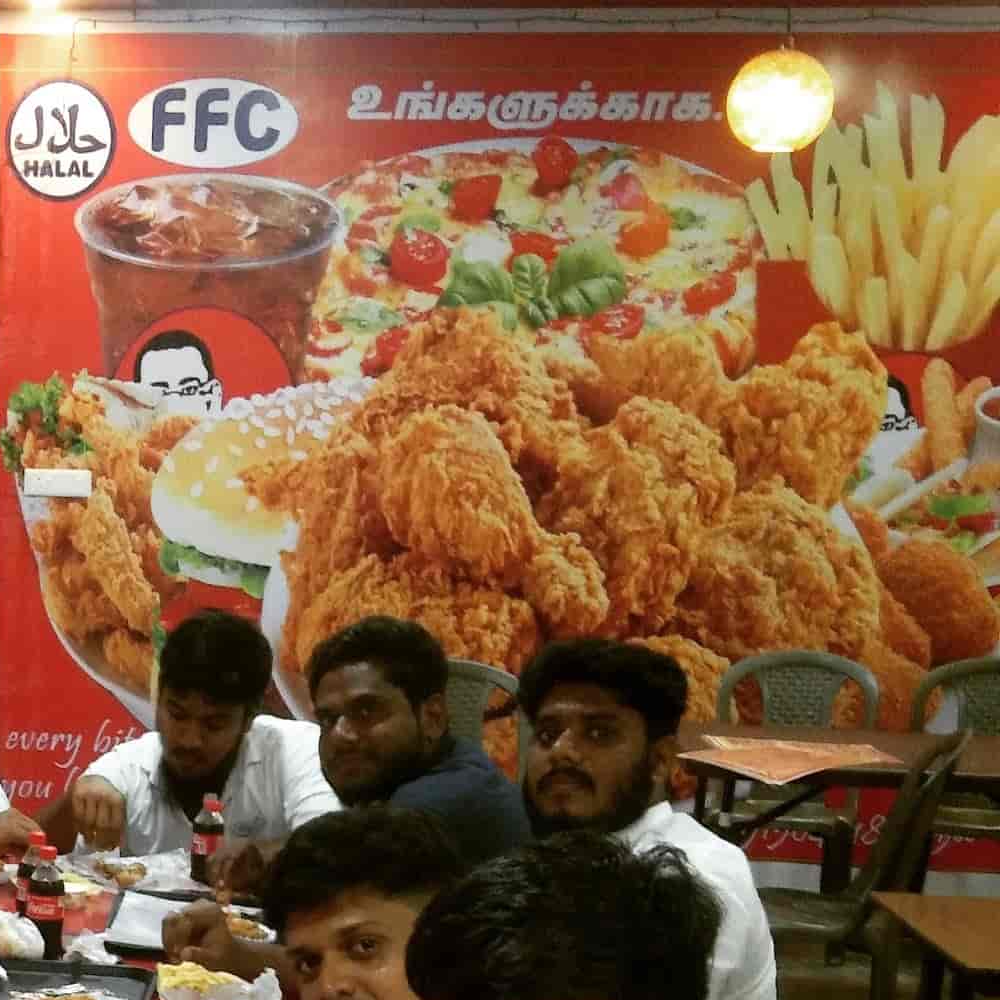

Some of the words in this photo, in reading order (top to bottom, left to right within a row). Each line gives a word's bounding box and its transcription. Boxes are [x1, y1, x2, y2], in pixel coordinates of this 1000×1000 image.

[15, 104, 107, 154] حلال
[151, 88, 280, 152] FFC
[24, 160, 94, 178] HALAL
[5, 729, 82, 769] every
[93, 719, 140, 752] bit
[0, 779, 51, 801] you
